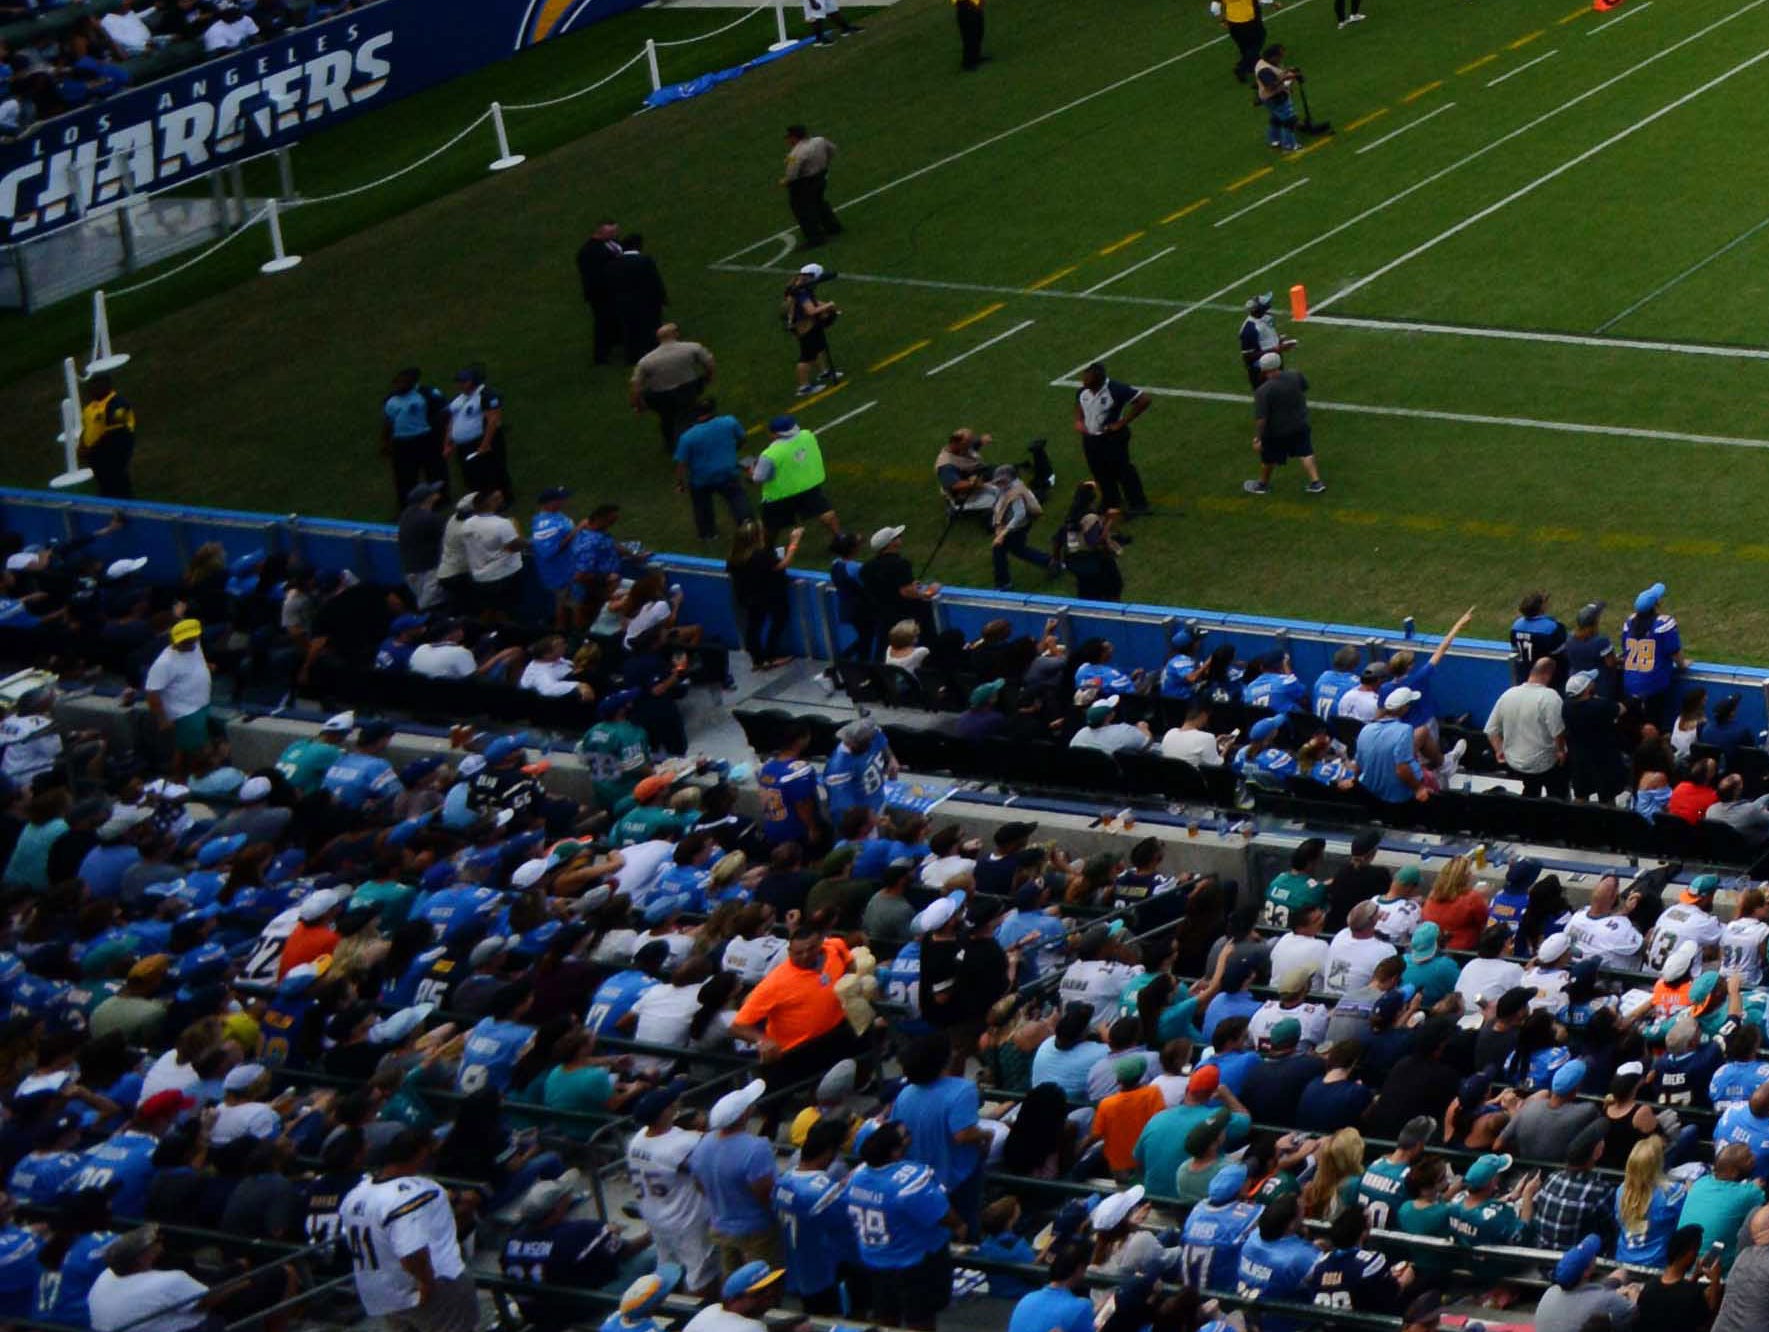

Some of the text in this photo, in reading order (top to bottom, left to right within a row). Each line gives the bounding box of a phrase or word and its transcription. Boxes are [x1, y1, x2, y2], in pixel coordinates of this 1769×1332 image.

[0, 31, 394, 236] CHARGERS
[34, 23, 359, 157] LOS ANGELES
[1624, 638, 1656, 672] 28
